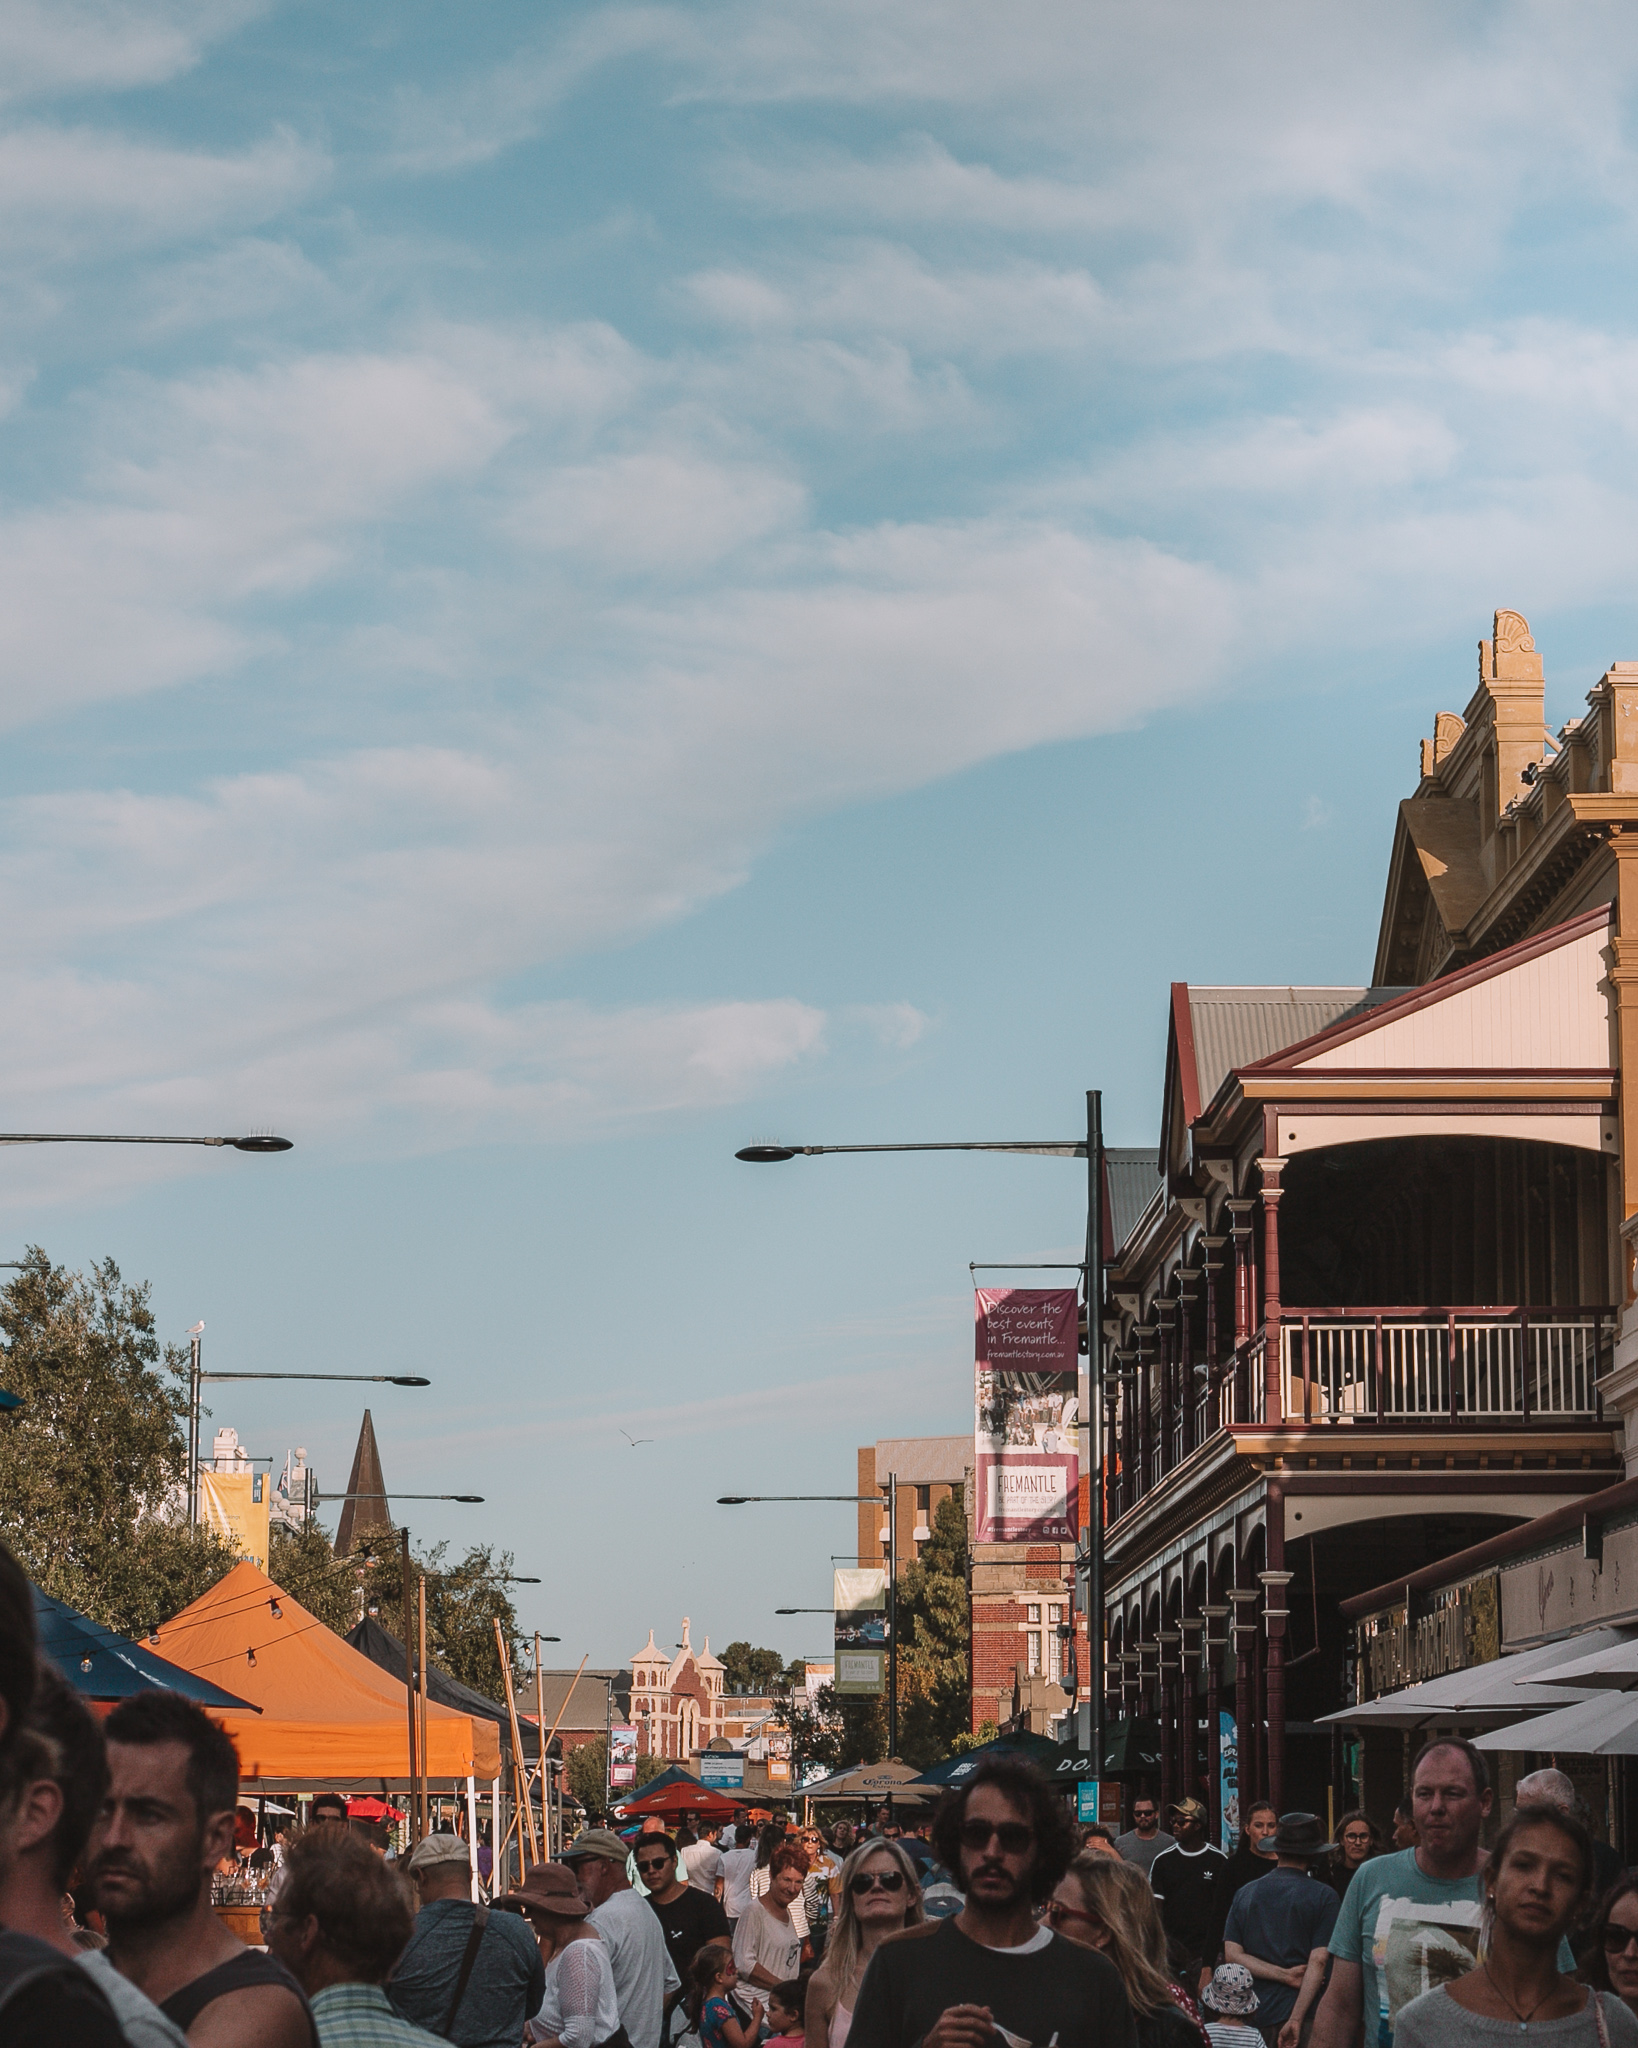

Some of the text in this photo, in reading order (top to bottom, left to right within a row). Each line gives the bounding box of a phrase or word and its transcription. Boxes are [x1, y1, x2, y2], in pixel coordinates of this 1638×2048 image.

[987, 1302, 1063, 1315] Discover the
[987, 1317, 1054, 1330] best events
[987, 1331, 1066, 1345] in Fremantle...
[997, 1475, 1057, 1493] FREMANTLE
[1056, 1754, 1115, 1771] DOE
[862, 1777, 902, 1786] Corona
